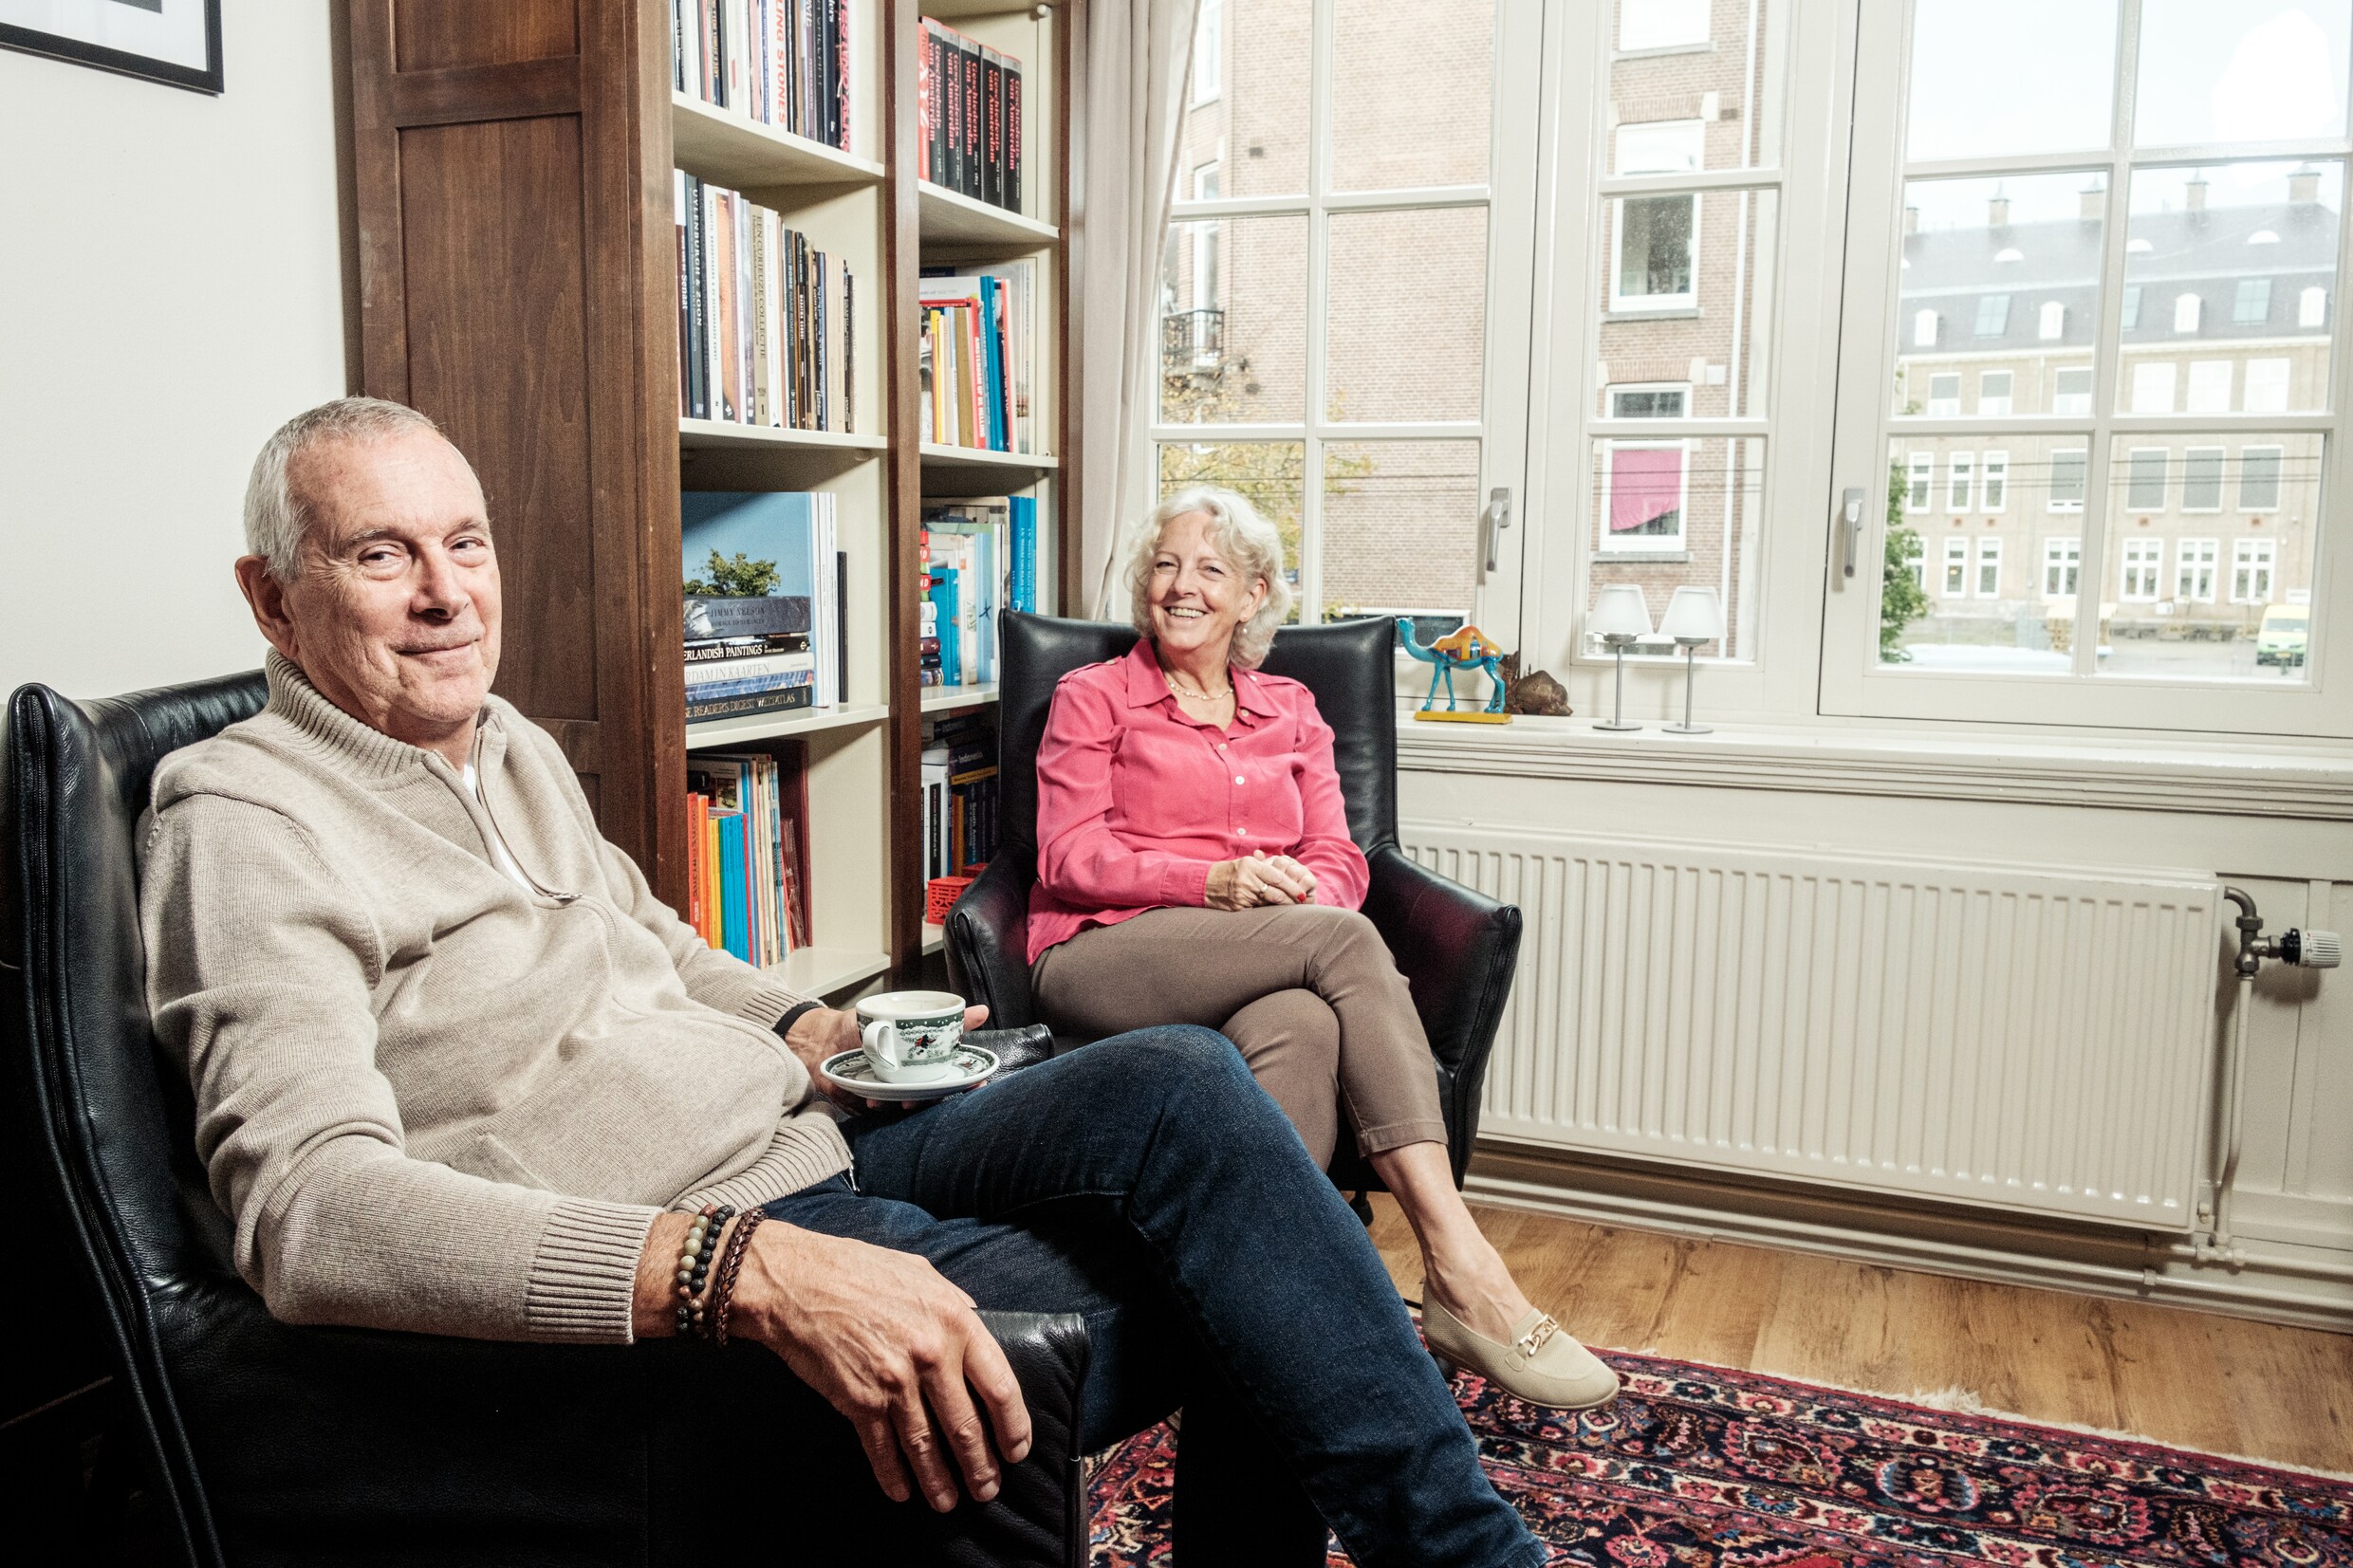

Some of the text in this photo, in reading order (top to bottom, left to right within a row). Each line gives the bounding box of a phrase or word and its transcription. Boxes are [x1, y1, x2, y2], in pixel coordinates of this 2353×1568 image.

[777, 48, 787, 123] STONES
[693, 189, 701, 275] UYLENBURGH
[974, 337, 983, 385] AMSTERDAM
[711, 607, 765, 618] JIMMY NELSON
[684, 644, 763, 661] ERLANDISH PAINTINGS
[686, 670, 713, 683] RDAM
[728, 663, 770, 679] KAARTEN
[730, 697, 756, 711] DIGEST
